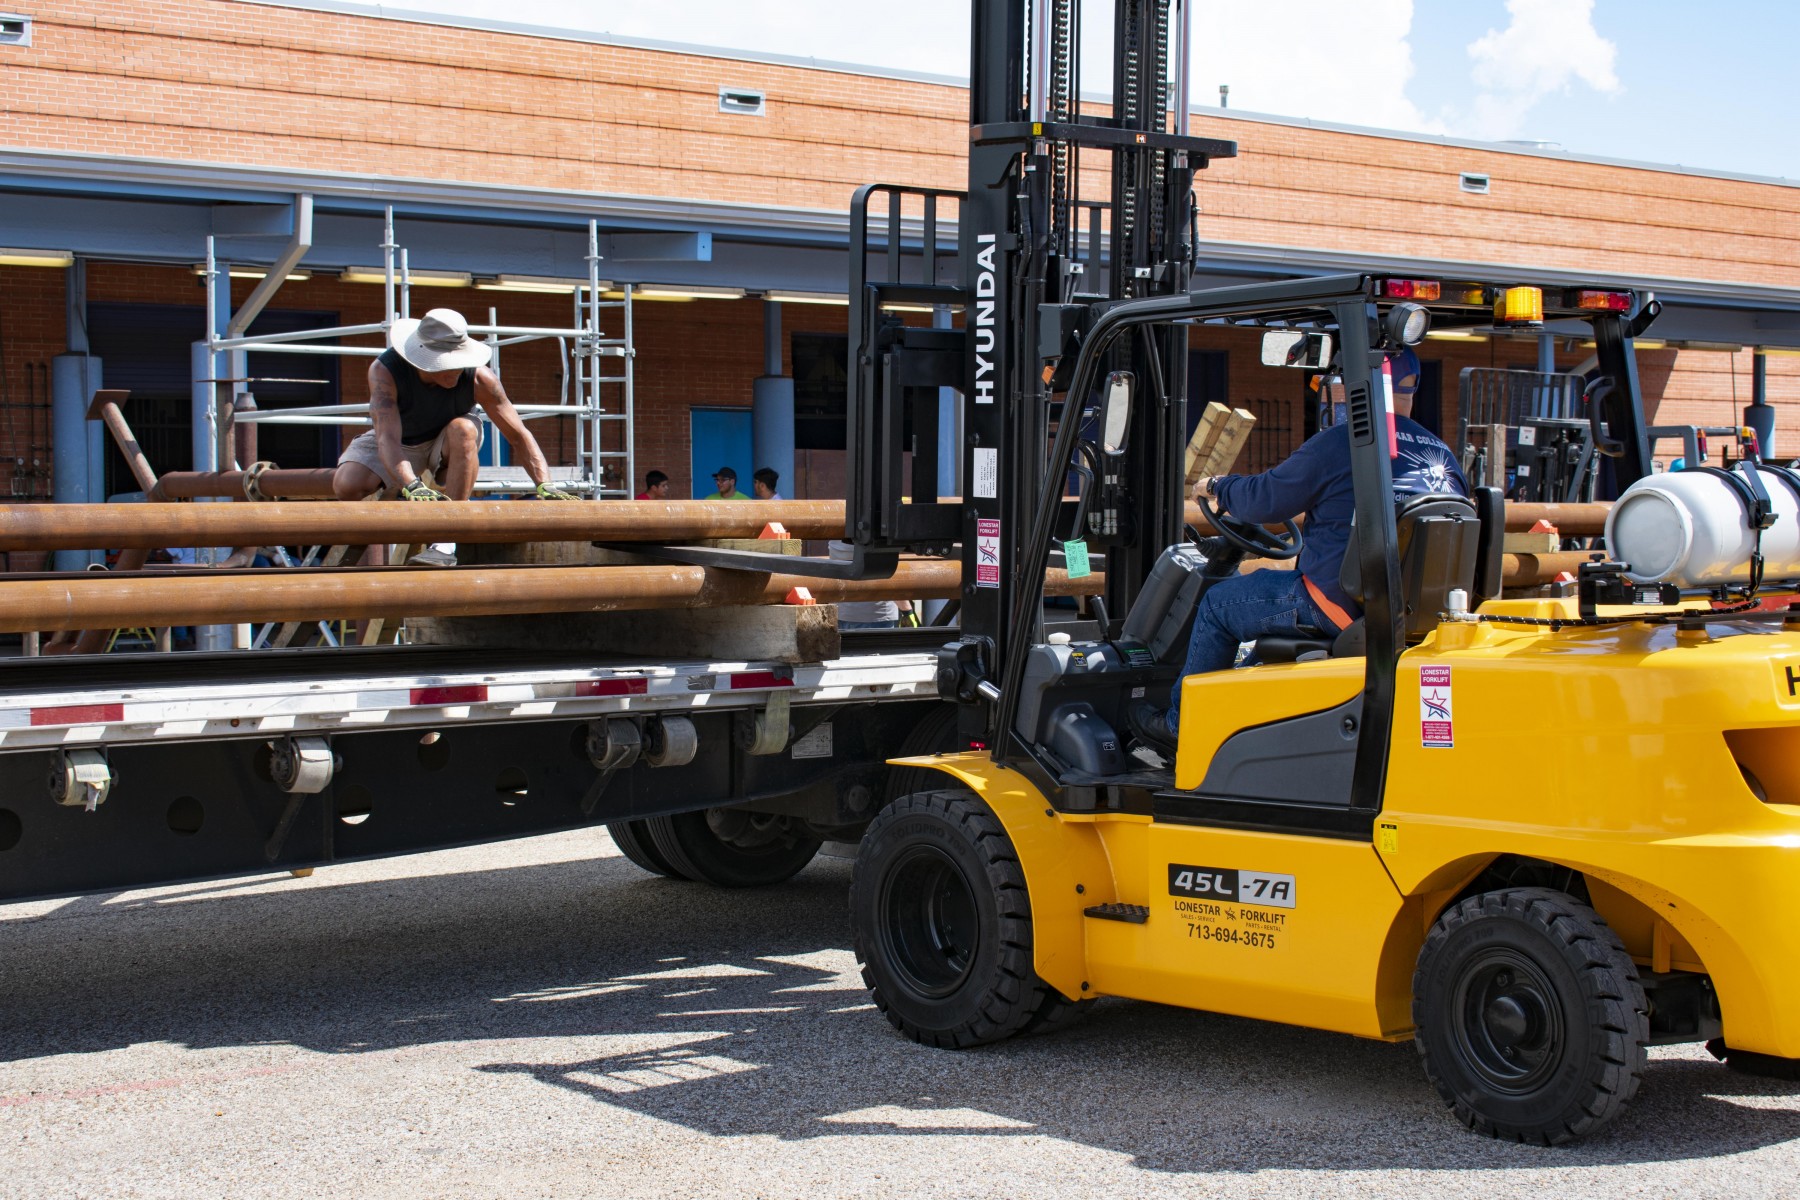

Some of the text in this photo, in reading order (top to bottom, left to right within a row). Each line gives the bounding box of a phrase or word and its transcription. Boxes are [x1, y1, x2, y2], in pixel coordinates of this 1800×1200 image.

[975, 233, 996, 404] HYUNDAI
[892, 822, 945, 843] SOLIDPRO
[1174, 900, 1286, 925] LONESTAR FORKLIFT
[1187, 923, 1275, 949] 713-694-3675
